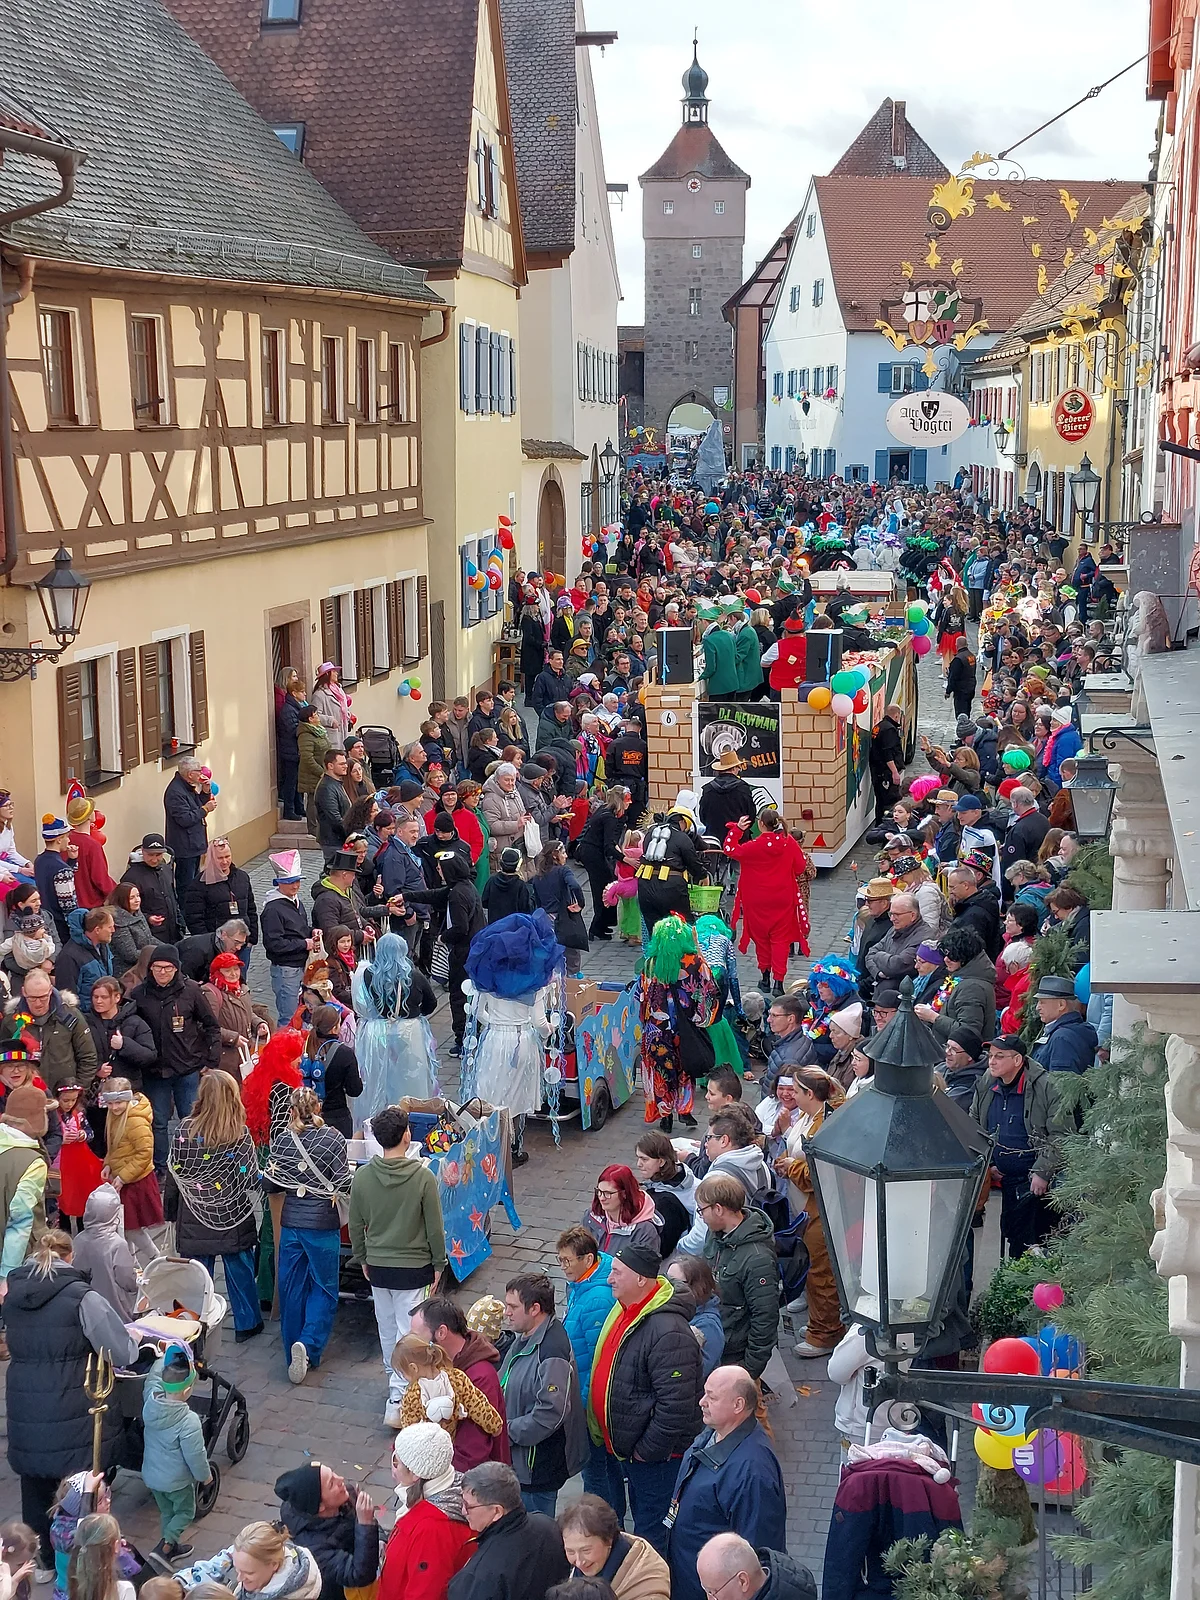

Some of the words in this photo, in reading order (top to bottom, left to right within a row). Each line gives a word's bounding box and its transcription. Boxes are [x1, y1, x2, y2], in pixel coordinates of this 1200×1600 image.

[900, 407, 919, 418] Alte
[1056, 412, 1092, 427] Lederer
[909, 418, 952, 435] Vogtei
[1061, 423, 1087, 434] Biere
[666, 712, 672, 724] 6
[718, 707, 731, 720] DJ
[735, 711, 779, 732] NEWMAN
[750, 735, 761, 748] &
